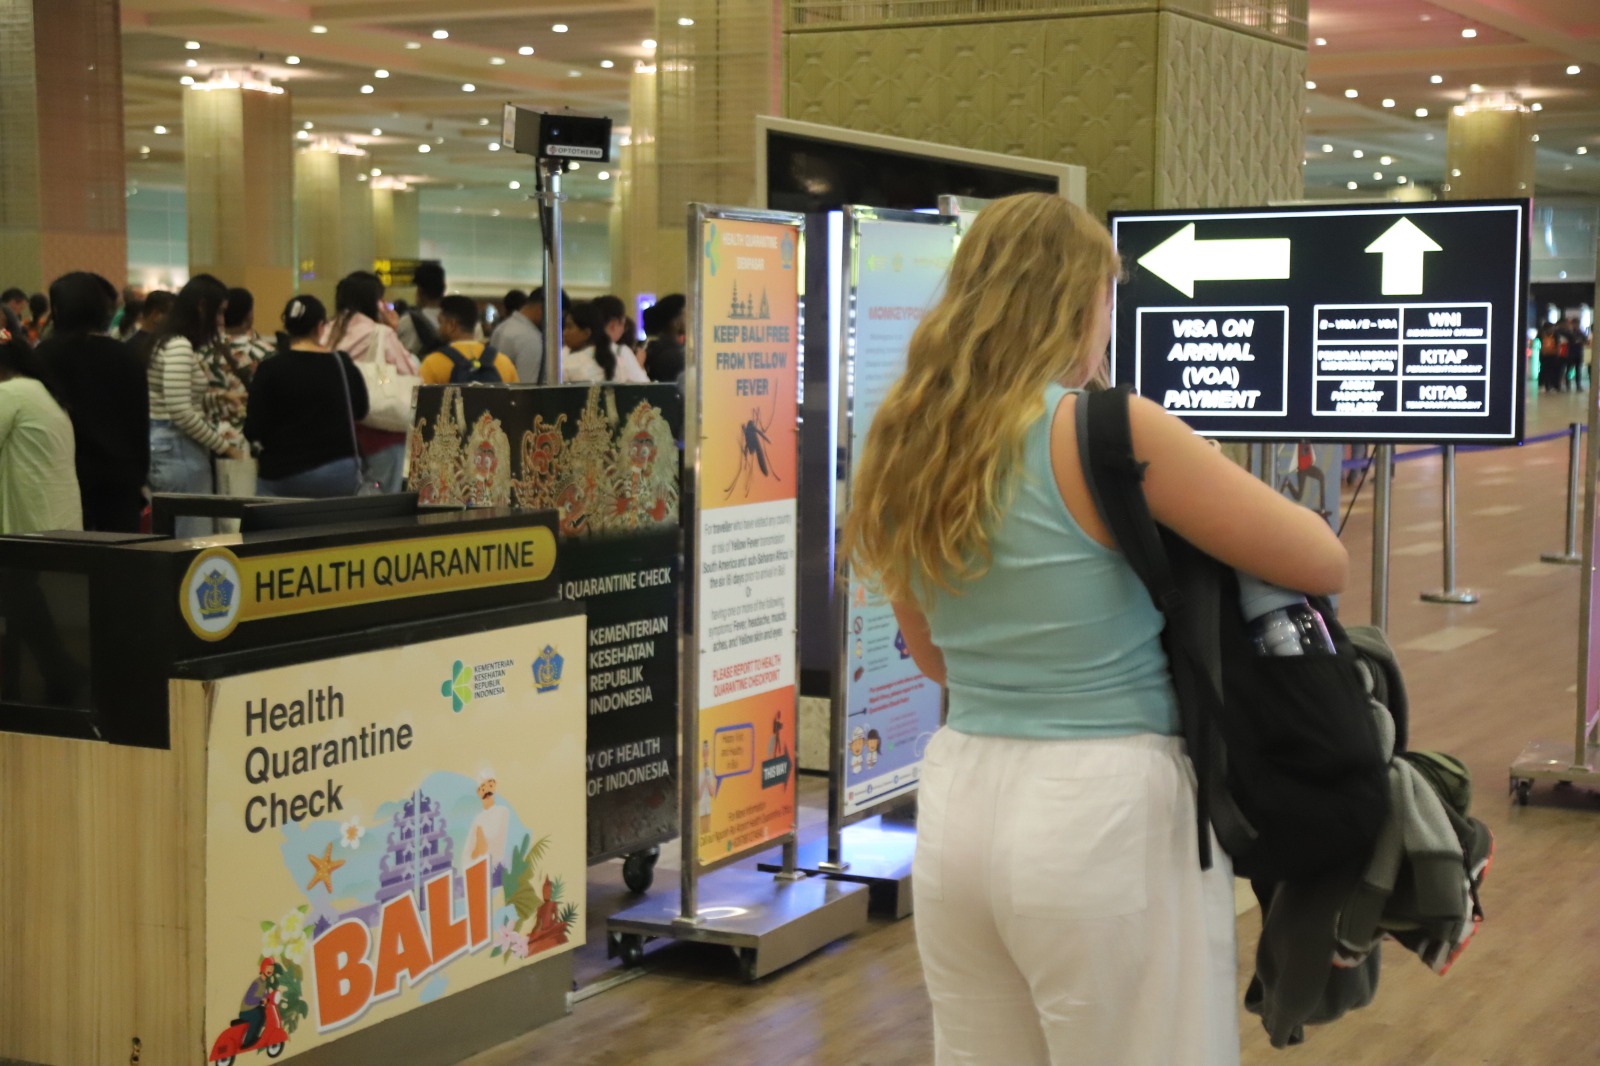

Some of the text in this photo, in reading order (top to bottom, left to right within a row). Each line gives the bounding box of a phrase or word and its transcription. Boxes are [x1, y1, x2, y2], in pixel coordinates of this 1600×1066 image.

[558, 147, 600, 156] OPTOTHERM
[1172, 318, 1254, 338] VISA ON
[1428, 312, 1461, 328] WNI
[714, 325, 790, 343] KEEP BALI FREE
[716, 352, 787, 370] FROM YELLOW
[1167, 343, 1255, 362] ARRIVAL
[1420, 349, 1468, 364] KITAP
[736, 378, 769, 396] FEVER
[1182, 366, 1240, 389] (VOA)
[1163, 390, 1261, 409] PAYMENT
[1420, 385, 1468, 400] KITAS
[731, 538, 746, 551] Yellow
[747, 537, 759, 548] Fever
[255, 540, 534, 602] HEALTH QUARANTINE
[703, 562, 718, 574] South
[718, 559, 737, 571] America
[566, 572, 636, 600] QUARANTINE
[638, 568, 672, 588] CHECK
[590, 616, 668, 646] KEMENTERIAN
[739, 634, 753, 646] Yellow
[590, 641, 654, 670] KESEHATAN
[474, 659, 514, 673] KEMENTERIAN
[713, 654, 782, 681] PLEASE REPORT TO HEALTH
[474, 670, 506, 682] KESEHATAN
[474, 679, 500, 690] REPUBLIK
[590, 666, 644, 692] REPUBLIK
[714, 669, 780, 697] QUARANTINE CHECKPOINT
[474, 687, 505, 699] INDONESIA
[590, 686, 653, 715] INDONESIA
[246, 686, 344, 736] Health
[245, 722, 413, 784] Quarantine
[598, 749, 614, 768] OF
[616, 737, 660, 764] HEALTH
[587, 778, 603, 796] OF
[606, 759, 670, 792] INDONESIA
[764, 762, 788, 781] THIS WAY
[245, 779, 344, 834] Check
[311, 856, 490, 1030] BALI
